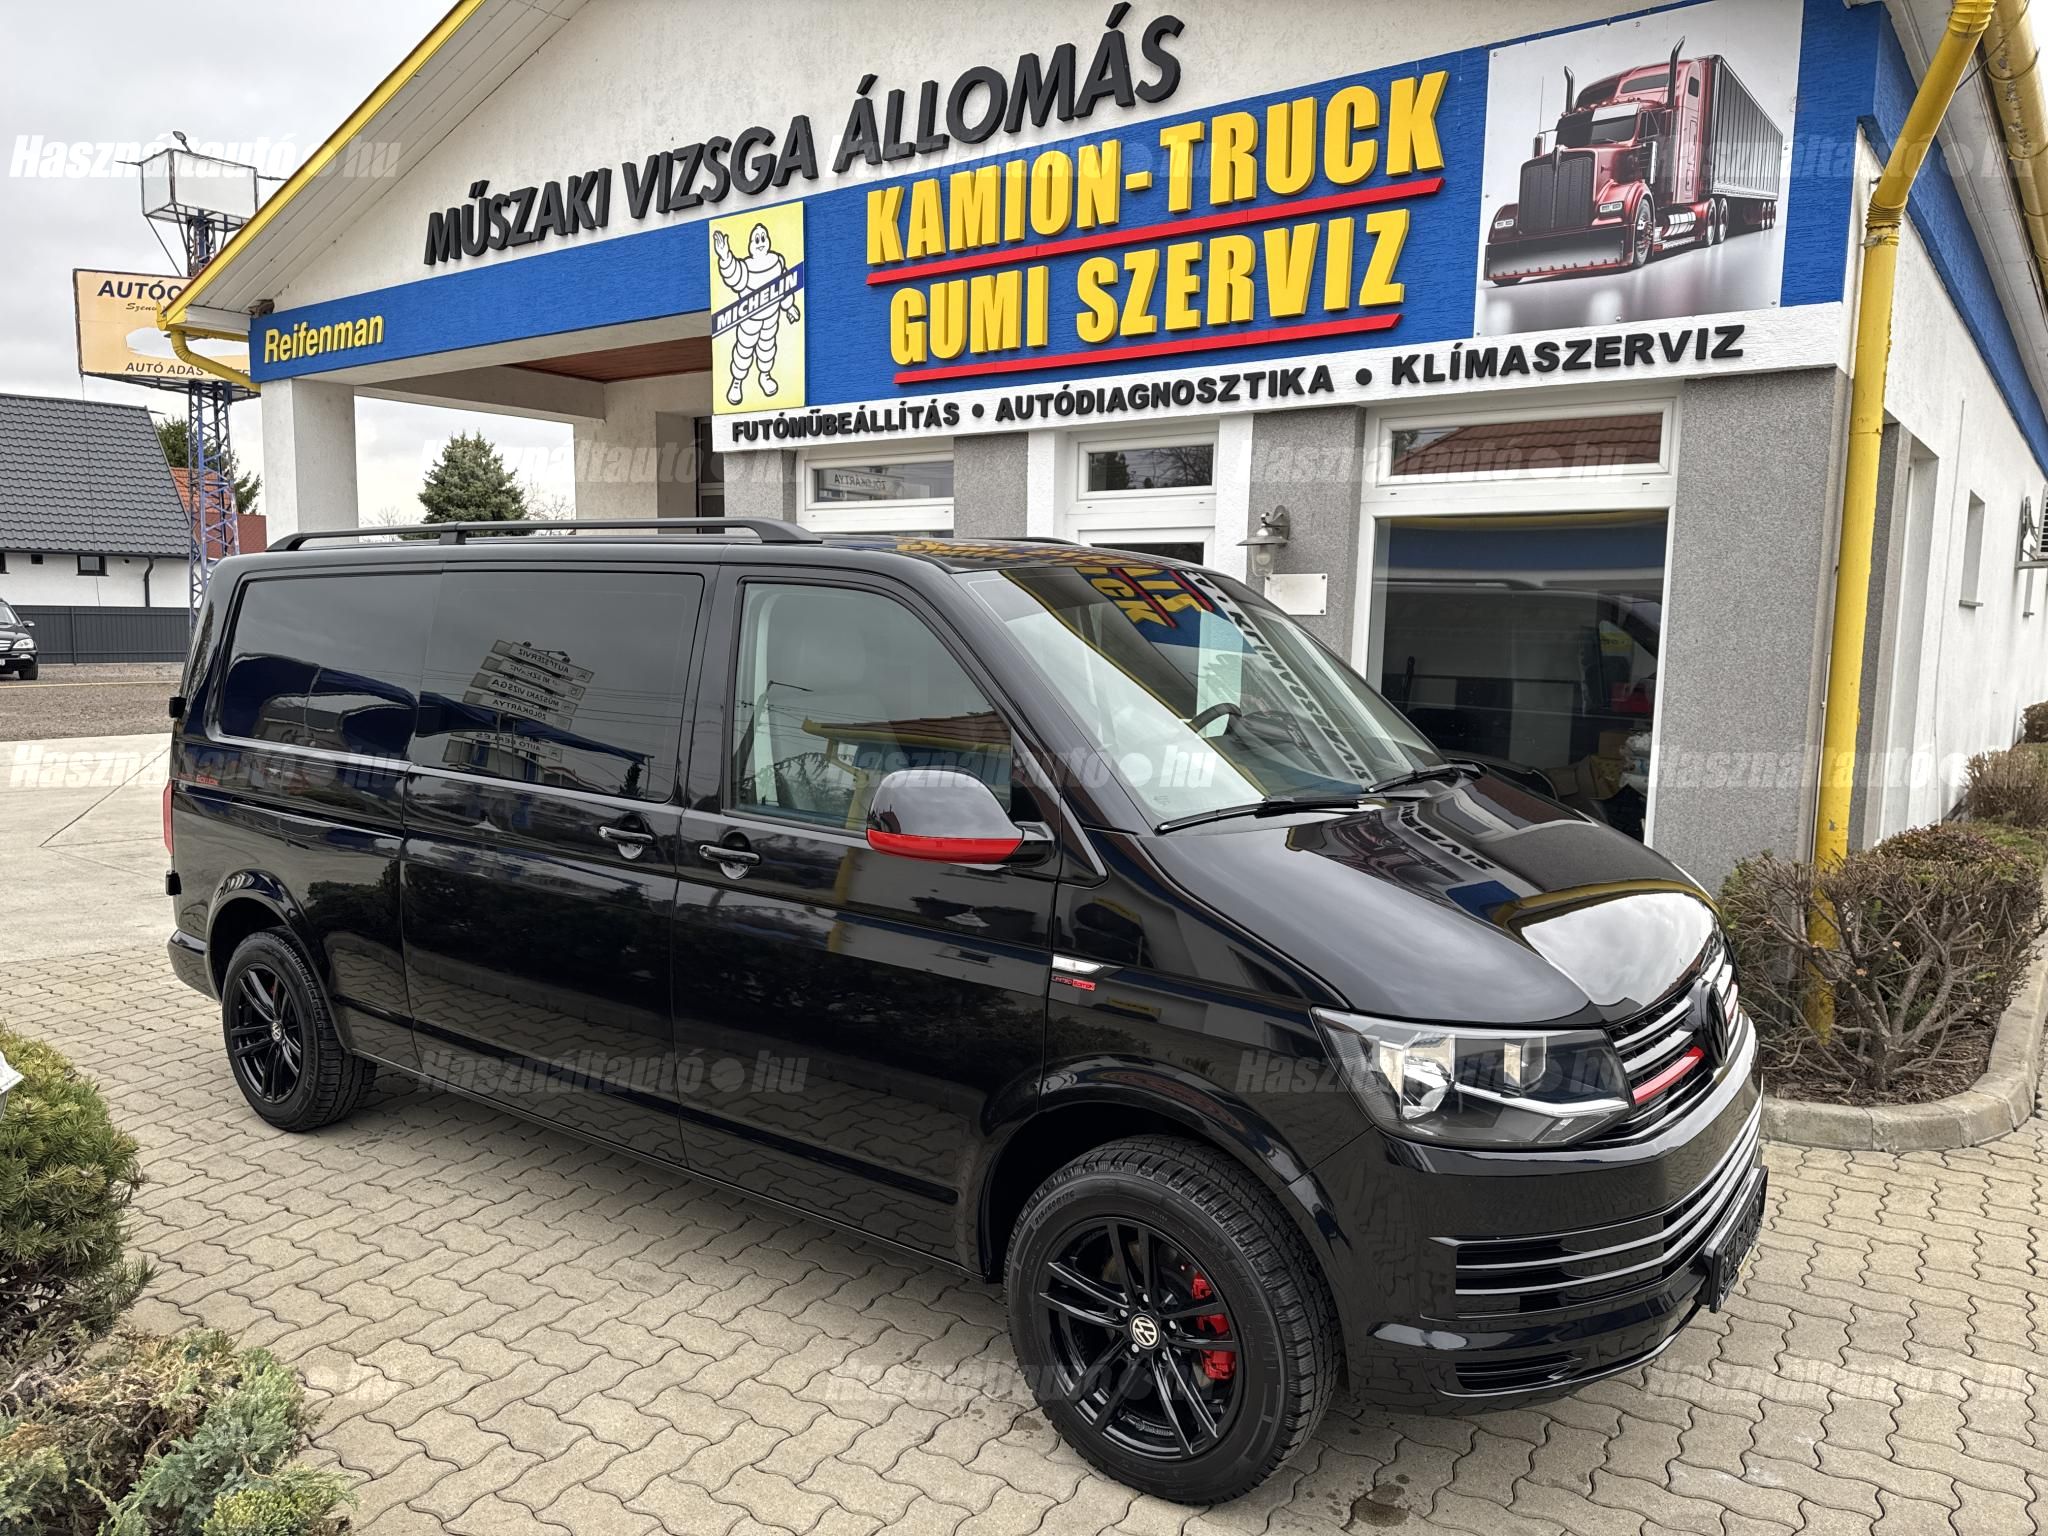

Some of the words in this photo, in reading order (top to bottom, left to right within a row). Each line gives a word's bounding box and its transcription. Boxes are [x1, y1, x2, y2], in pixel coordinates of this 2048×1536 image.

[424, 180, 613, 265] MŰSZAKI
[622, 114, 819, 219] VIZSGA
[832, 2, 1185, 174] ÁLLOMÁS
[716, 270, 798, 331] MICHELIN
[890, 265, 1049, 366] GUMI
[1076, 208, 1410, 343] SZERVIZ
[126, 362, 164, 374] AUTÓ
[264, 315, 384, 364] Reifenman
[732, 398, 960, 442] FUTÓMŰBEÁLLÍTÁS
[996, 365, 1334, 421] AUTÓDIAGNOSZTIKA
[1391, 324, 1746, 385] KLÍMASZERVIZ
